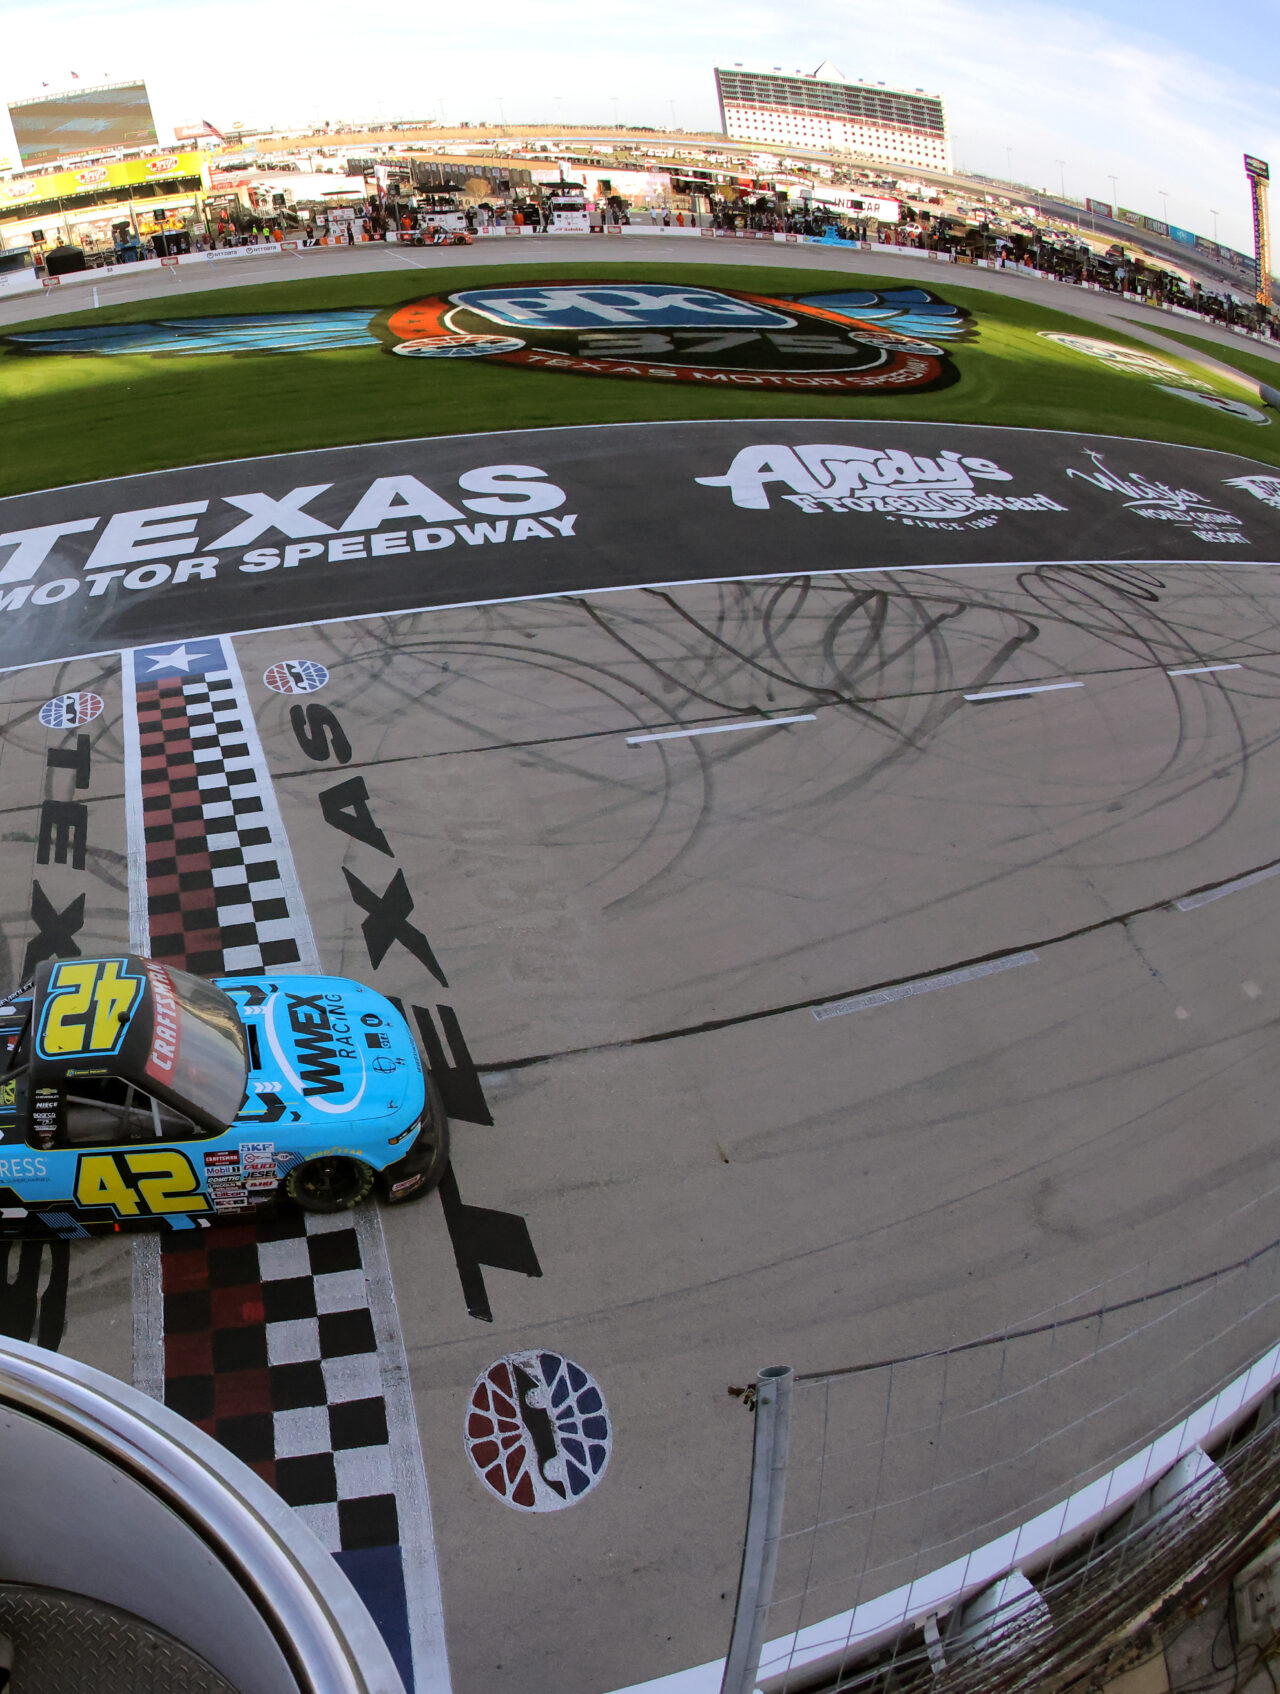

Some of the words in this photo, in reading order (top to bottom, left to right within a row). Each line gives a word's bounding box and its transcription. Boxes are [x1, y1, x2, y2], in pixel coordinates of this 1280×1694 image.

[833, 196, 880, 213] INDCAR
[482, 287, 758, 323] PPG
[576, 332, 862, 357] 375
[526, 354, 678, 379] TEXAS
[704, 372, 848, 388] MOTOR
[696, 443, 1014, 510] Andy's
[781, 493, 933, 514] Frozen
[925, 490, 1069, 514] Custard
[901, 517, 965, 532] SINCE
[236, 513, 580, 575] SPEEDWAY
[43, 960, 139, 1055] 42
[146, 962, 177, 1071] CRAFTSMAN
[284, 991, 345, 1097] WWEX
[324, 993, 358, 1060] RACING
[240, 1143, 273, 1152] SKF
[76, 1151, 210, 1216] 42
[206, 1166, 231, 1174] Mobil
[243, 1170, 277, 1179] JESEL
